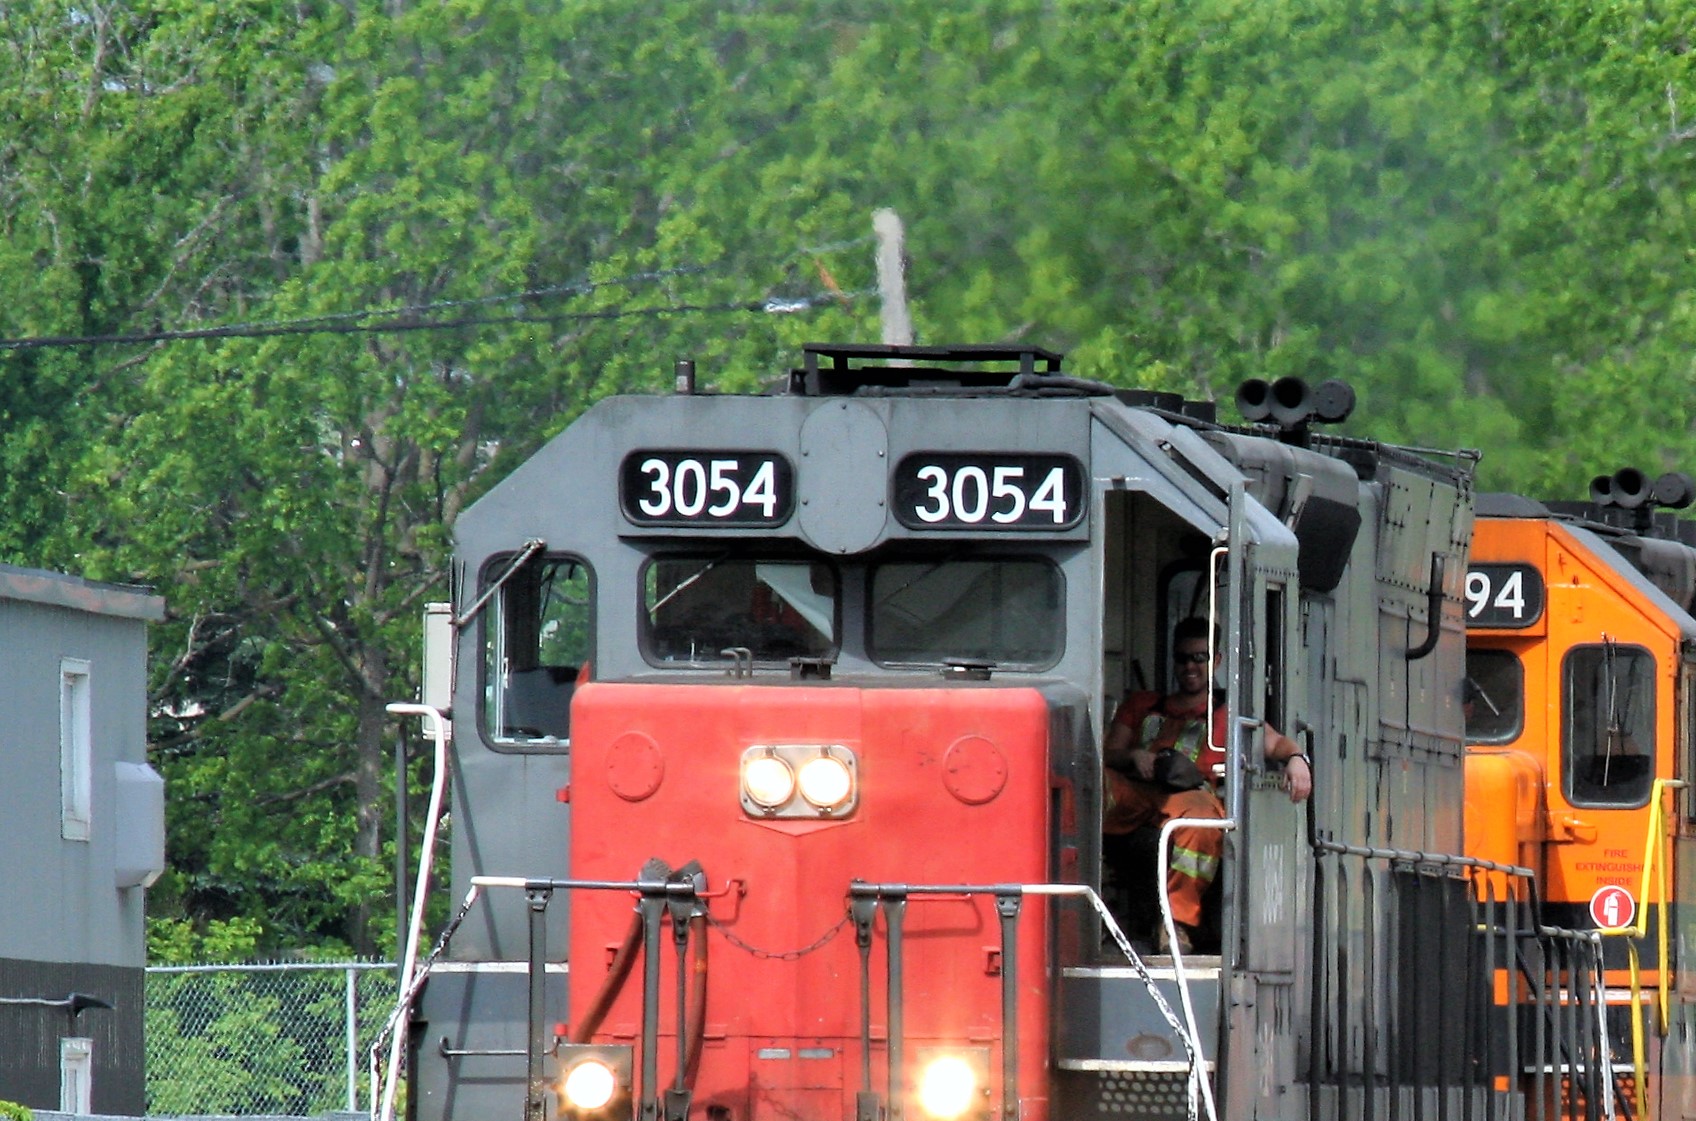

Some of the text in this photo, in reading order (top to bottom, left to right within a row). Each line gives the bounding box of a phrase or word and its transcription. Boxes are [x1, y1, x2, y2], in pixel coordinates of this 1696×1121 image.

[639, 458, 777, 518] 3054
[914, 465, 1067, 524] 3054
[1464, 570, 1526, 619] 94
[1575, 862, 1656, 873] EXTINGUISHR
[1603, 848, 1628, 858] FIRE
[1596, 876, 1633, 886] INSIDE
